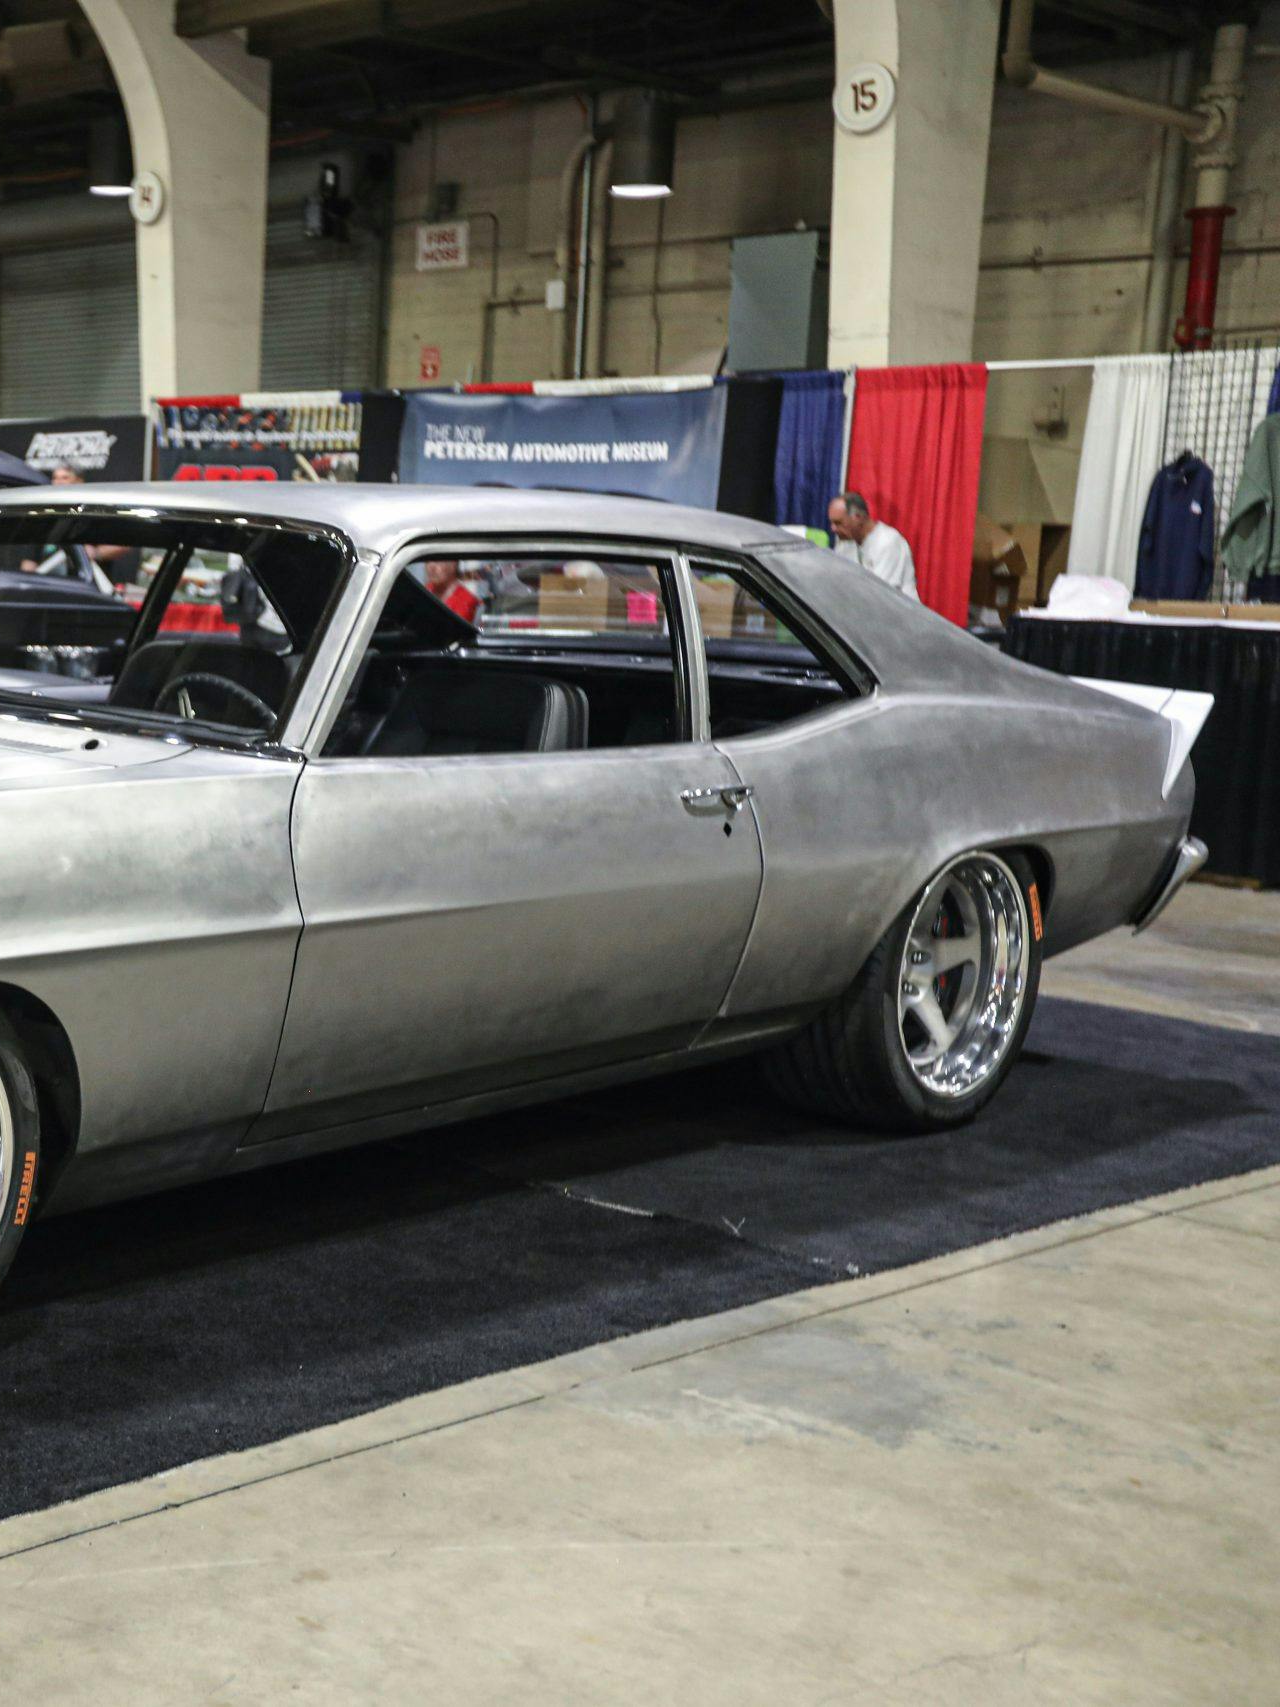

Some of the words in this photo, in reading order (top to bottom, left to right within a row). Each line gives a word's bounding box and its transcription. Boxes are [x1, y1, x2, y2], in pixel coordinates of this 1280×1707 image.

[850, 79, 877, 113] 15
[426, 229, 458, 244] FIRE
[423, 248, 460, 262] HOSE
[426, 423, 451, 441] THE
[454, 424, 485, 442] NEW
[424, 440, 508, 461] PETERSEN
[511, 443, 609, 463] AUTOMOTIVE
[612, 441, 668, 462] MUSEUM
